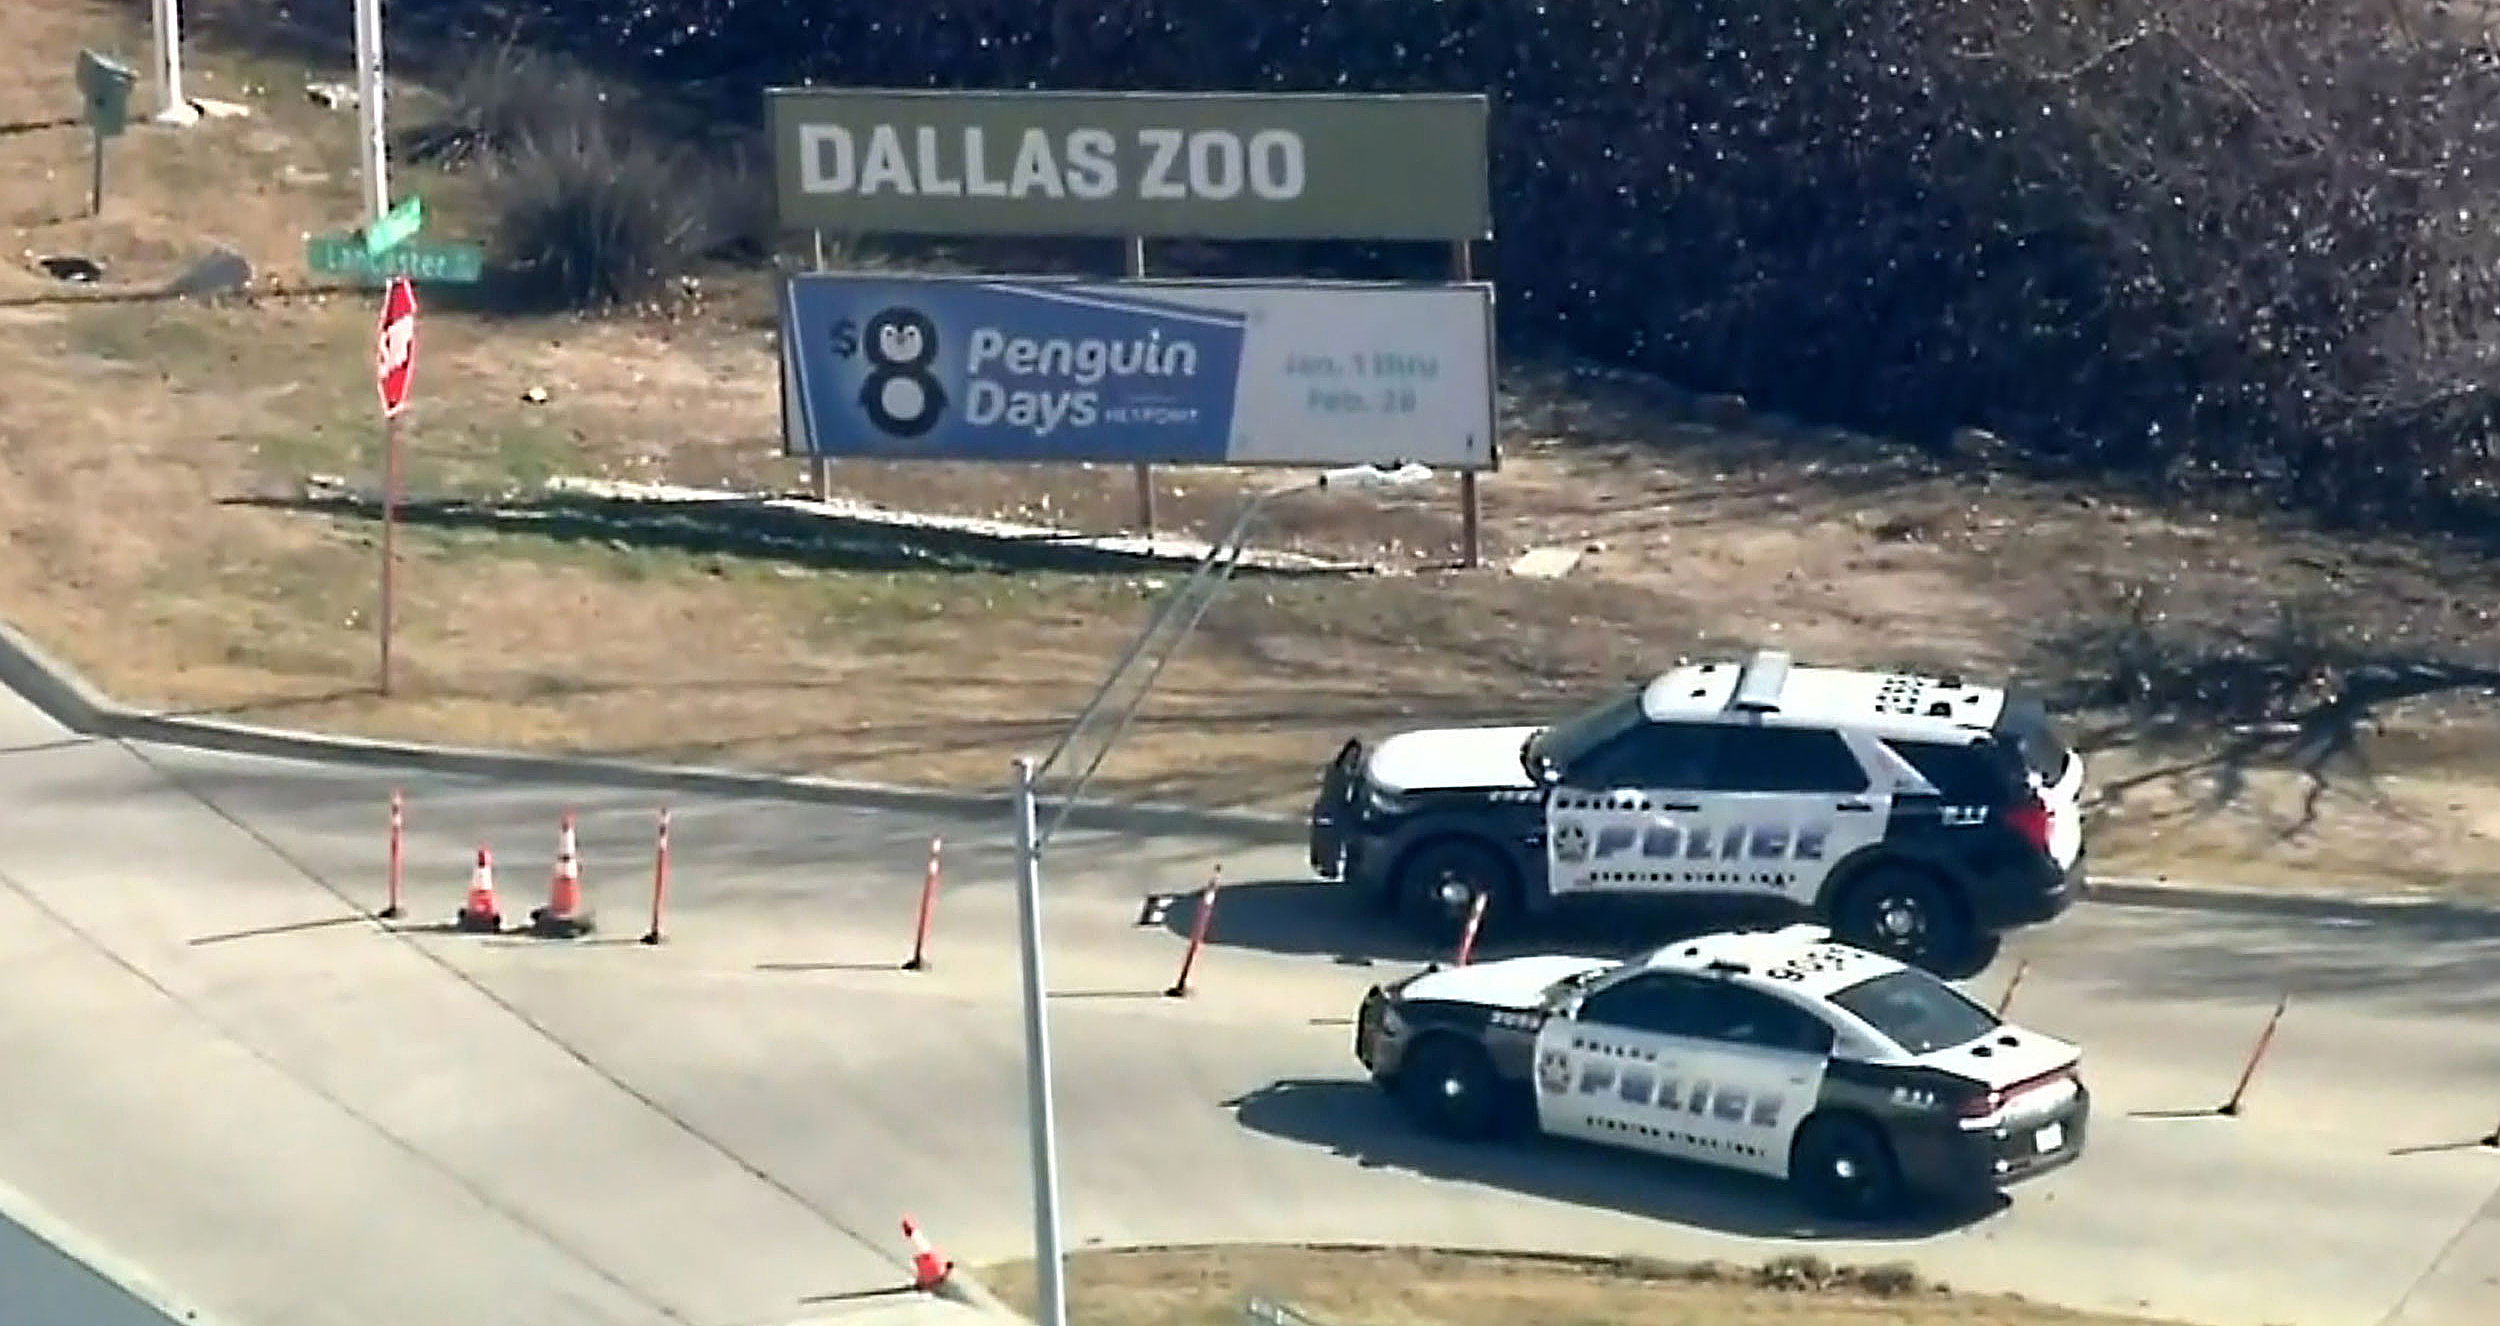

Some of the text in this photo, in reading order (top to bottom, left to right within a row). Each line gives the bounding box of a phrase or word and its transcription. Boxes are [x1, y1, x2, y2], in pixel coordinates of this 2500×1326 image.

[800, 124, 1305, 200] DALLAS ZOO
[966, 327, 1198, 385] Penguin
[964, 379, 1098, 437] Days
[1594, 825, 1832, 860] POLICE
[1578, 1060, 1783, 1129] POLICE
